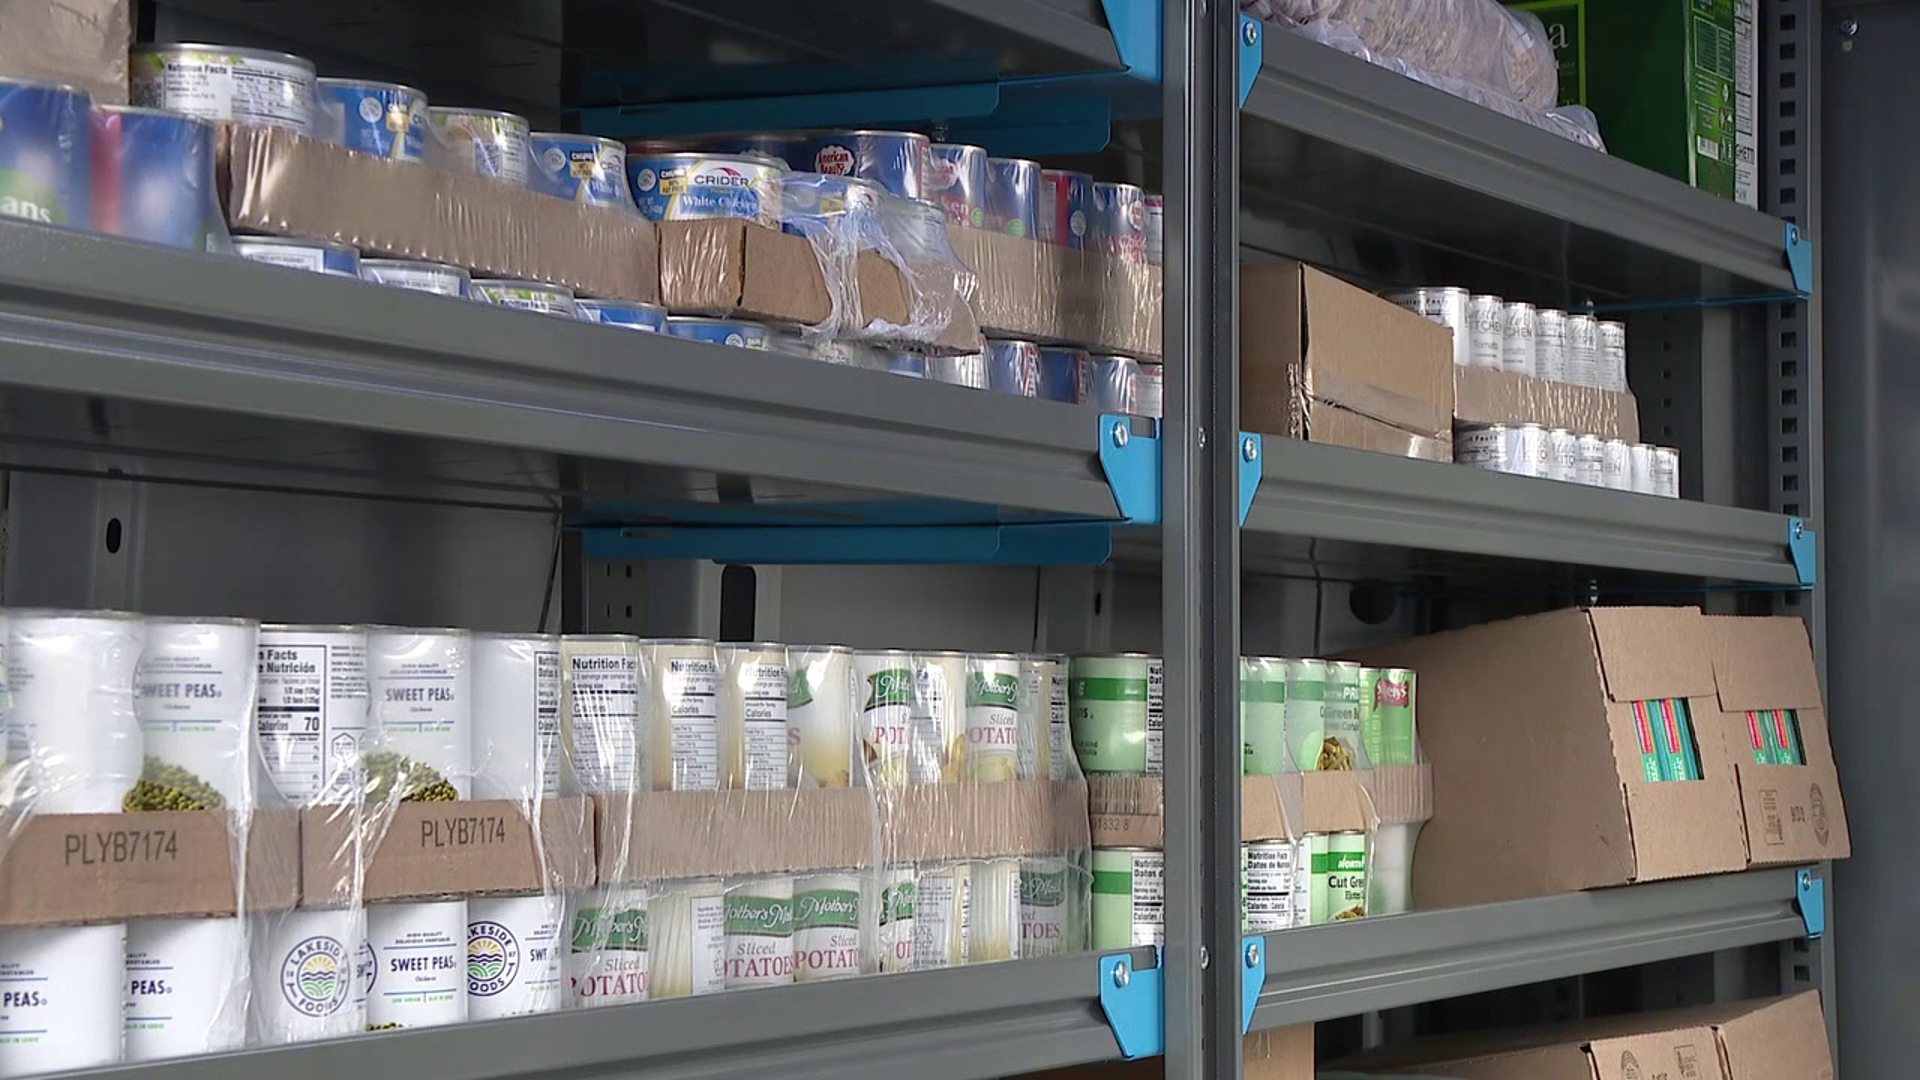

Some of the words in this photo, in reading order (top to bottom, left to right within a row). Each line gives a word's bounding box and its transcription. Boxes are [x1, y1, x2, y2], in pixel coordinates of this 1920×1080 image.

[694, 174, 750, 188] CRIDER
[683, 195, 717, 207] White
[267, 650, 298, 661] Facts
[267, 660, 317, 674] Nutrición
[572, 658, 620, 670] Nutrition
[185, 683, 216, 698] PEAS
[385, 688, 425, 702] SWEET
[428, 687, 452, 701] PEAS
[304, 717, 320, 732] 70
[420, 816, 505, 848] PLYB7174
[65, 830, 178, 866] PLYB7174
[1328, 875, 1348, 889] Cut
[468, 925, 513, 947] KESIDE
[737, 942, 777, 957] Sliced
[391, 957, 429, 972] SWEET
[432, 955, 454, 971] PEAS
[131, 980, 166, 996] PEAS
[468, 977, 505, 993] OODS
[4, 991, 40, 1008] PEAS
